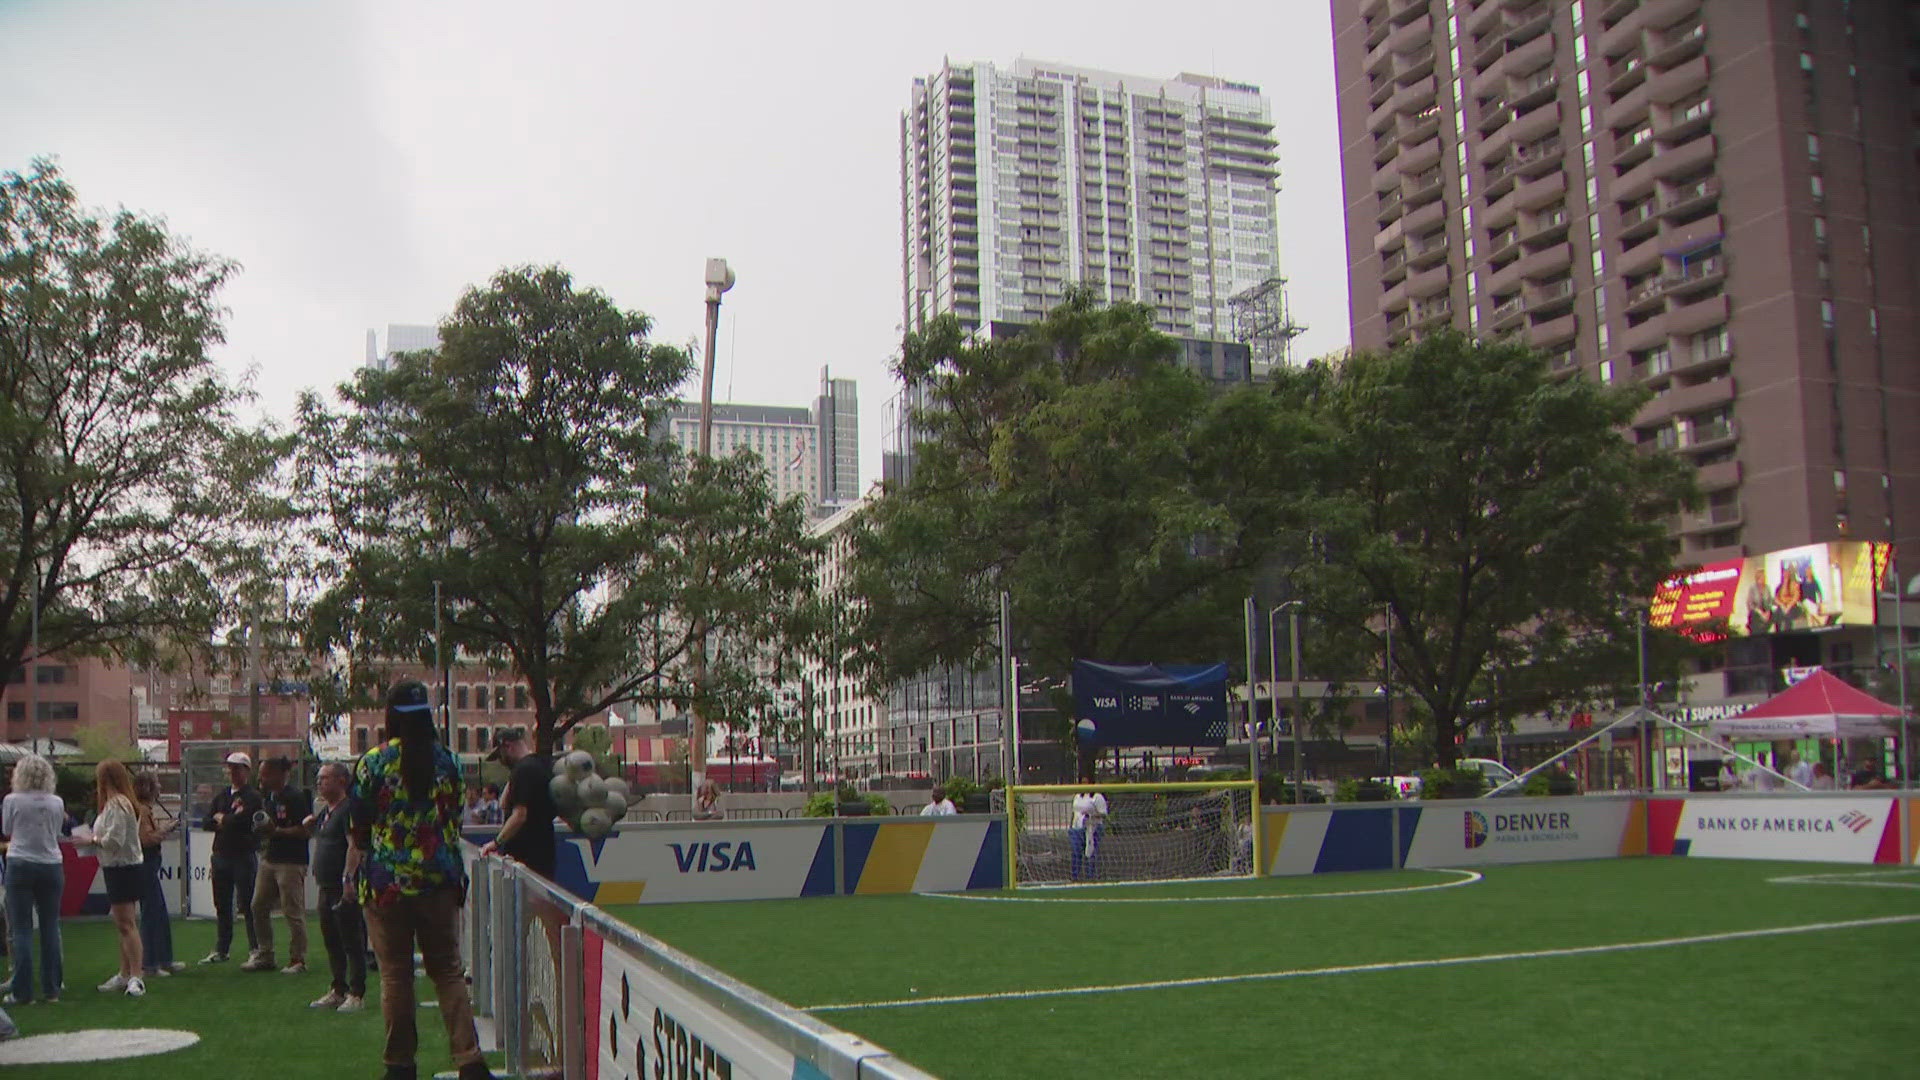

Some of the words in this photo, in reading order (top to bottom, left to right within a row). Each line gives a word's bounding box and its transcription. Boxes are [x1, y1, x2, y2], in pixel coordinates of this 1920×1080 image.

[1093, 697, 1117, 708] VISA
[1495, 812, 1570, 832] DENVER
[1698, 817, 1736, 830] BANK
[1740, 817, 1758, 831] OF
[1763, 818, 1834, 832] AMERICA
[665, 841, 756, 873] VISA
